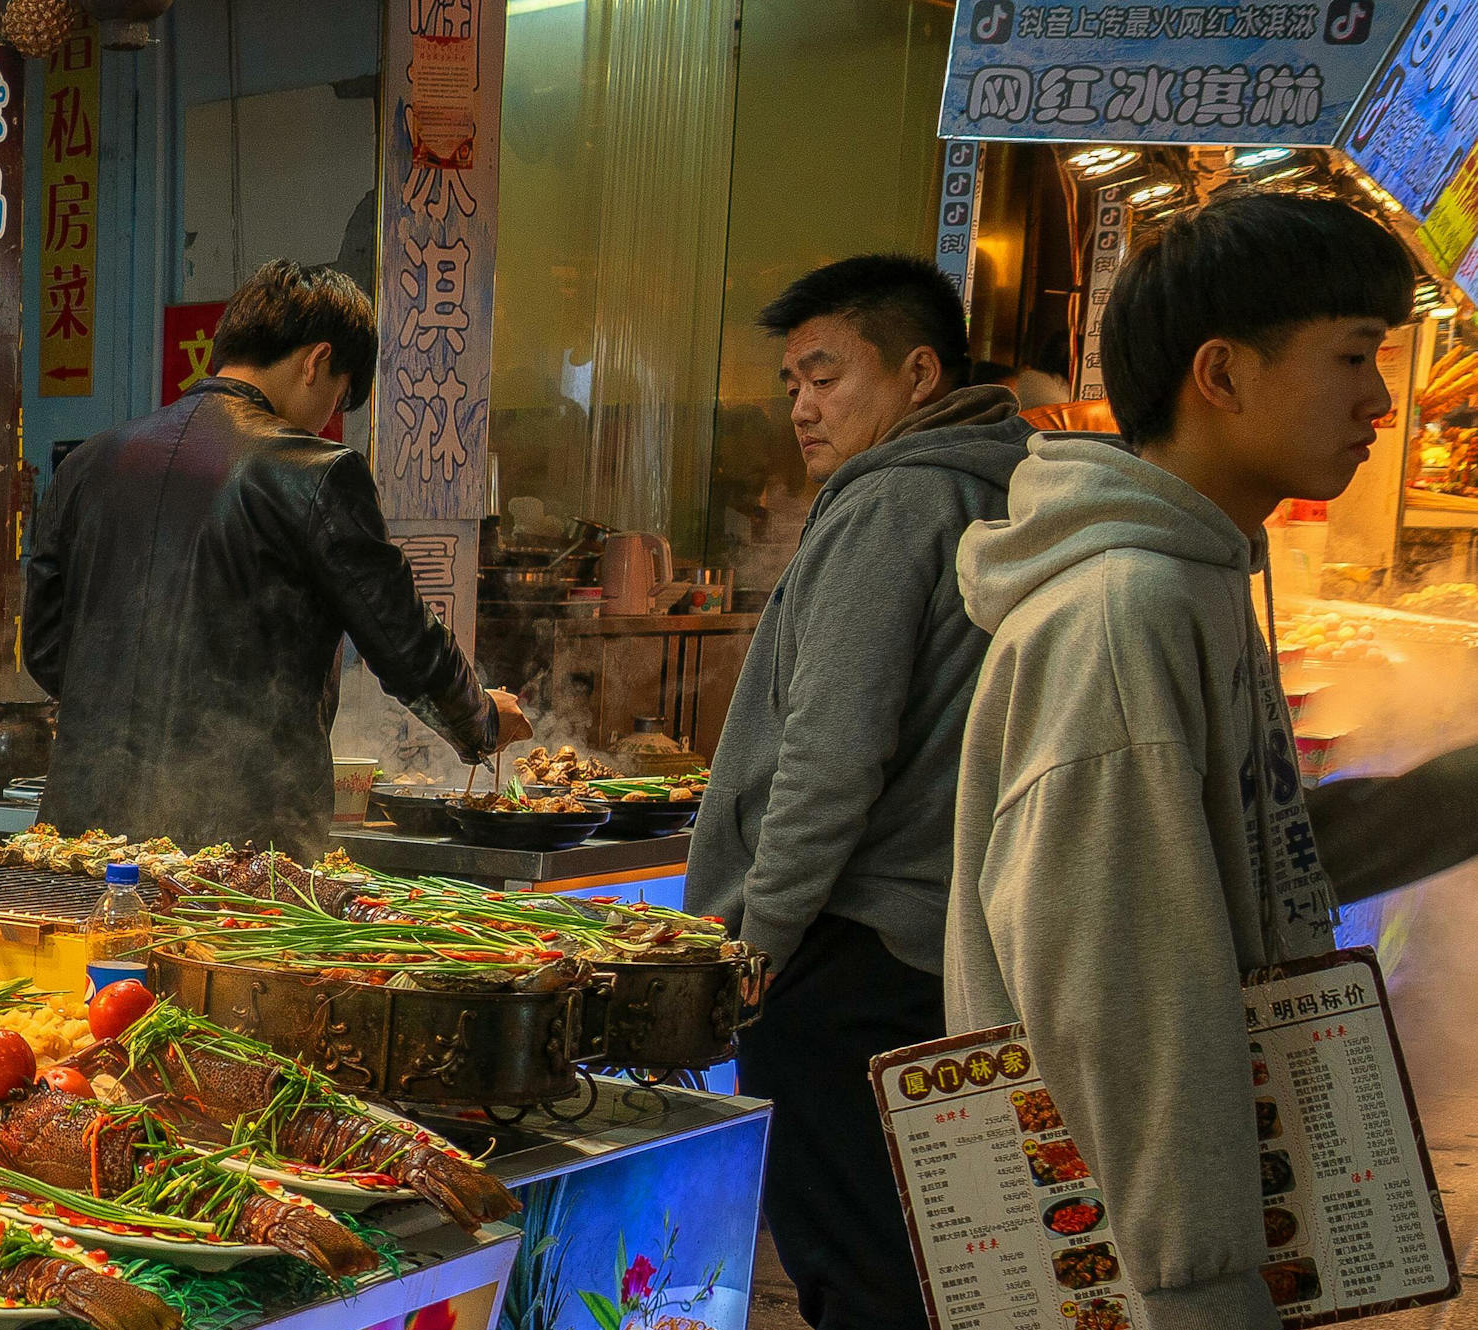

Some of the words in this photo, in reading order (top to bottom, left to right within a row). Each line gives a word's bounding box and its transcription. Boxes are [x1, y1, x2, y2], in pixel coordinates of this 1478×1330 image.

[1017, 4, 1319, 41] 抖音上传最火网红冰淇淋
[965, 64, 1325, 129] 网红冰淇淋
[1272, 983, 1367, 1021] 明码标价
[903, 1050, 1026, 1096] 厦门林家
